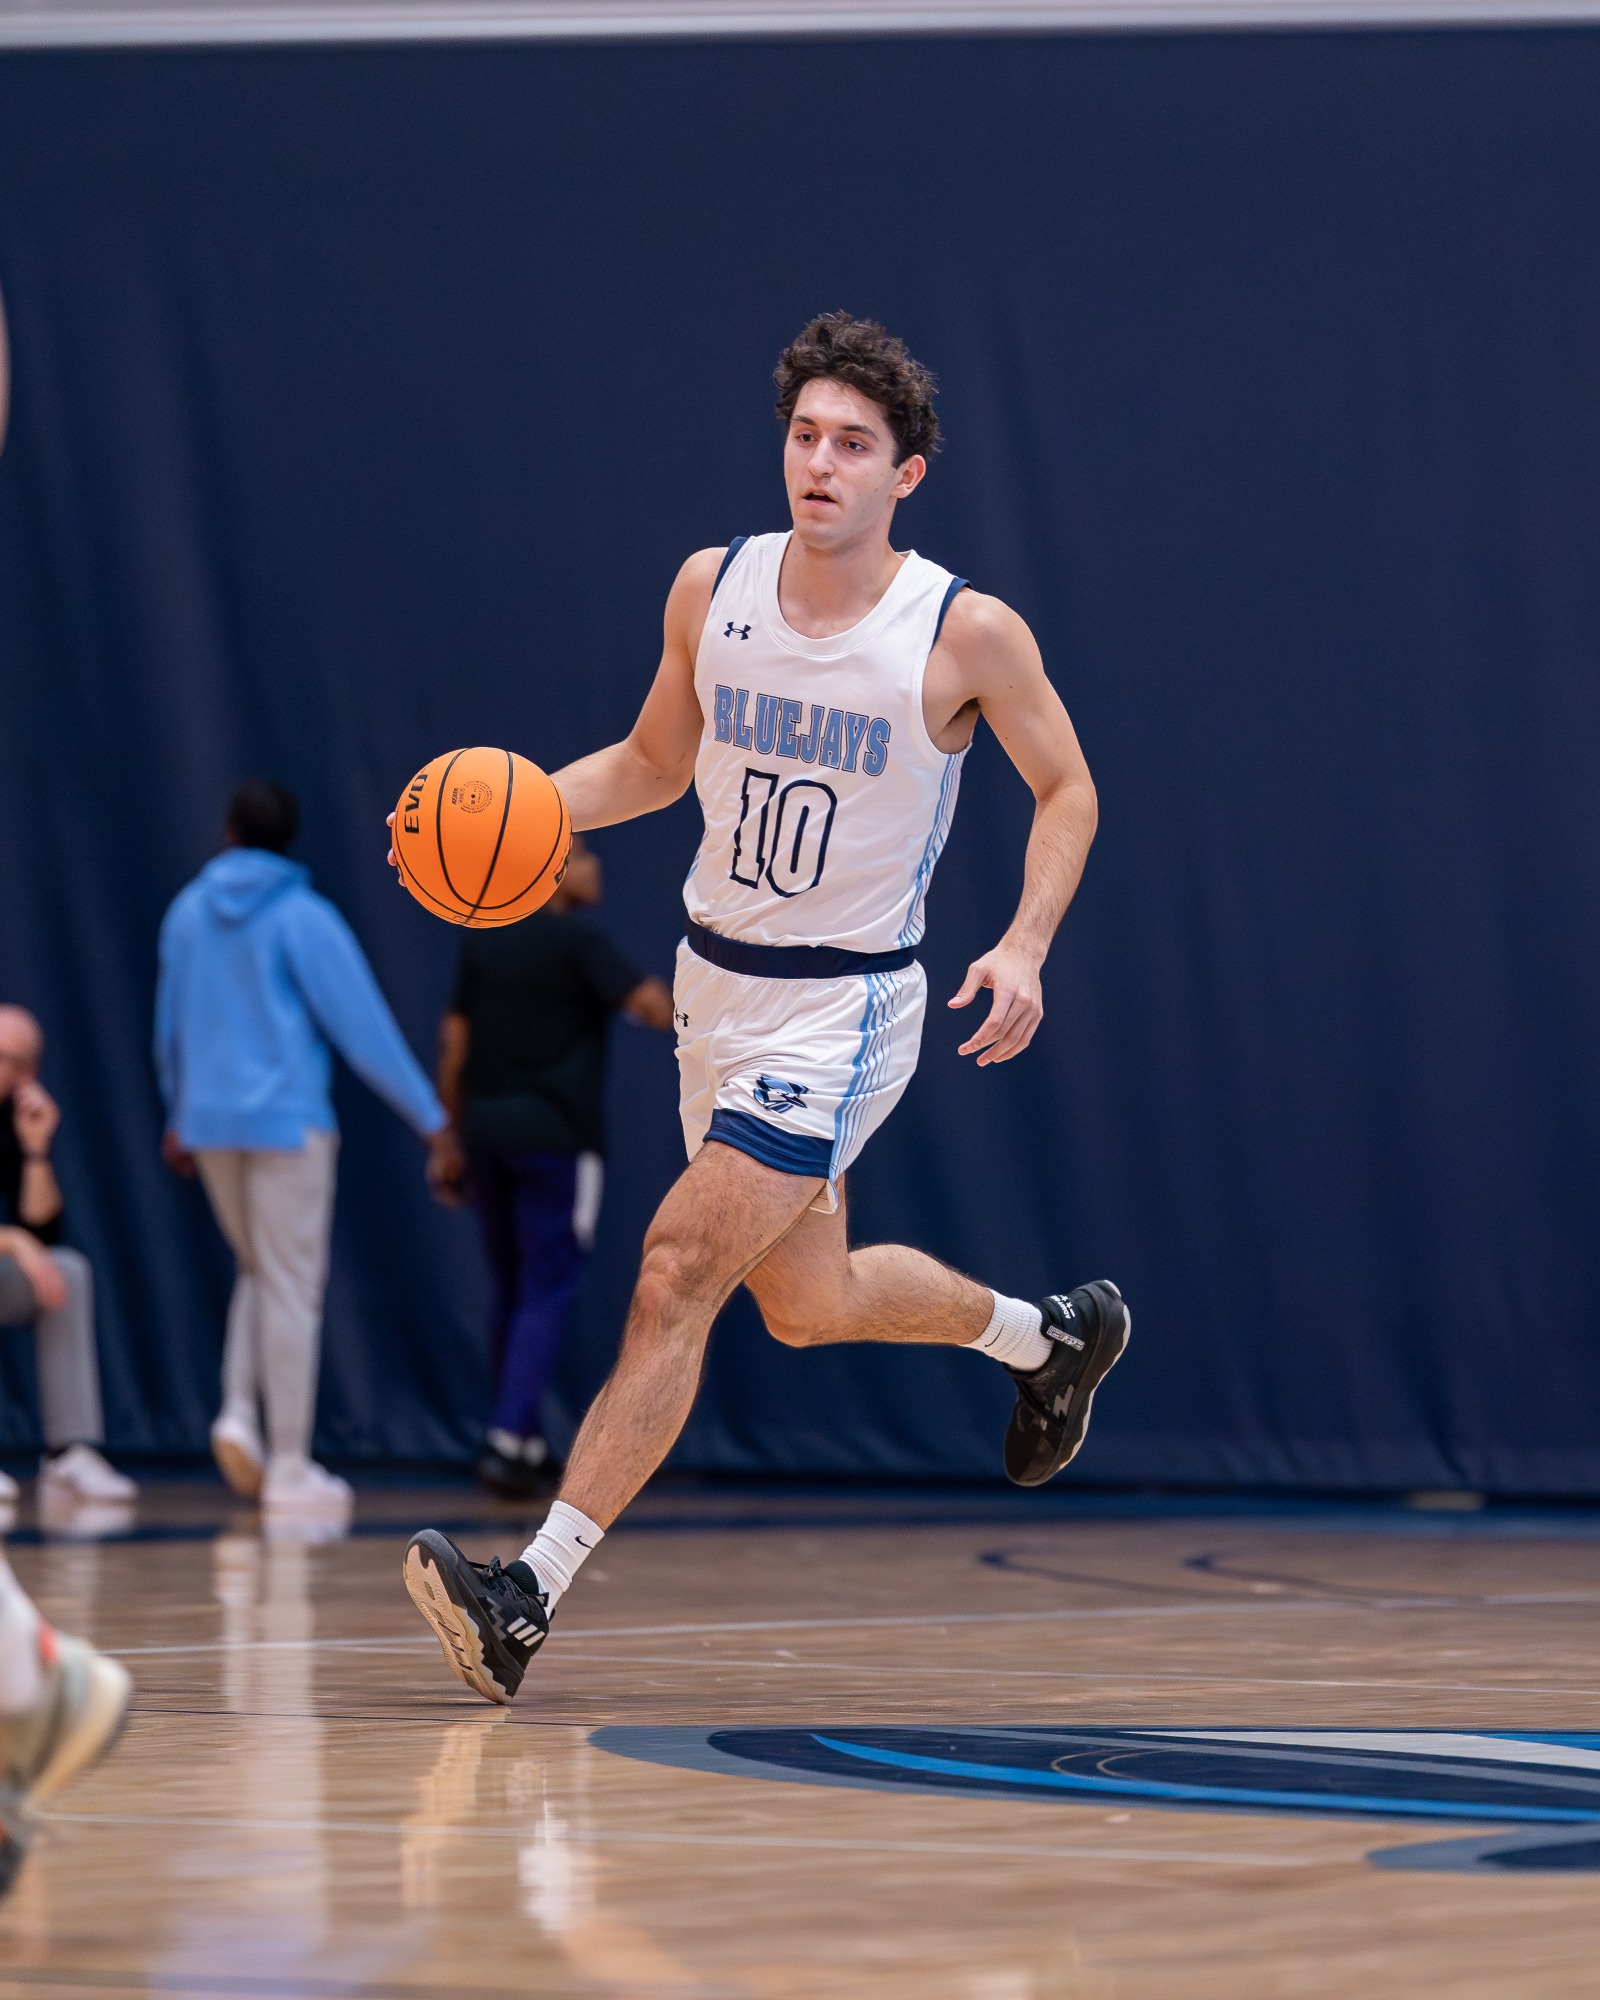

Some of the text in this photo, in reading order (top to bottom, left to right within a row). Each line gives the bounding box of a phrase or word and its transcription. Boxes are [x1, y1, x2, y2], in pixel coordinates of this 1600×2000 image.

[715, 684, 891, 776] BLUEJAYS
[404, 774, 428, 834] EVO
[729, 767, 837, 898] 10
